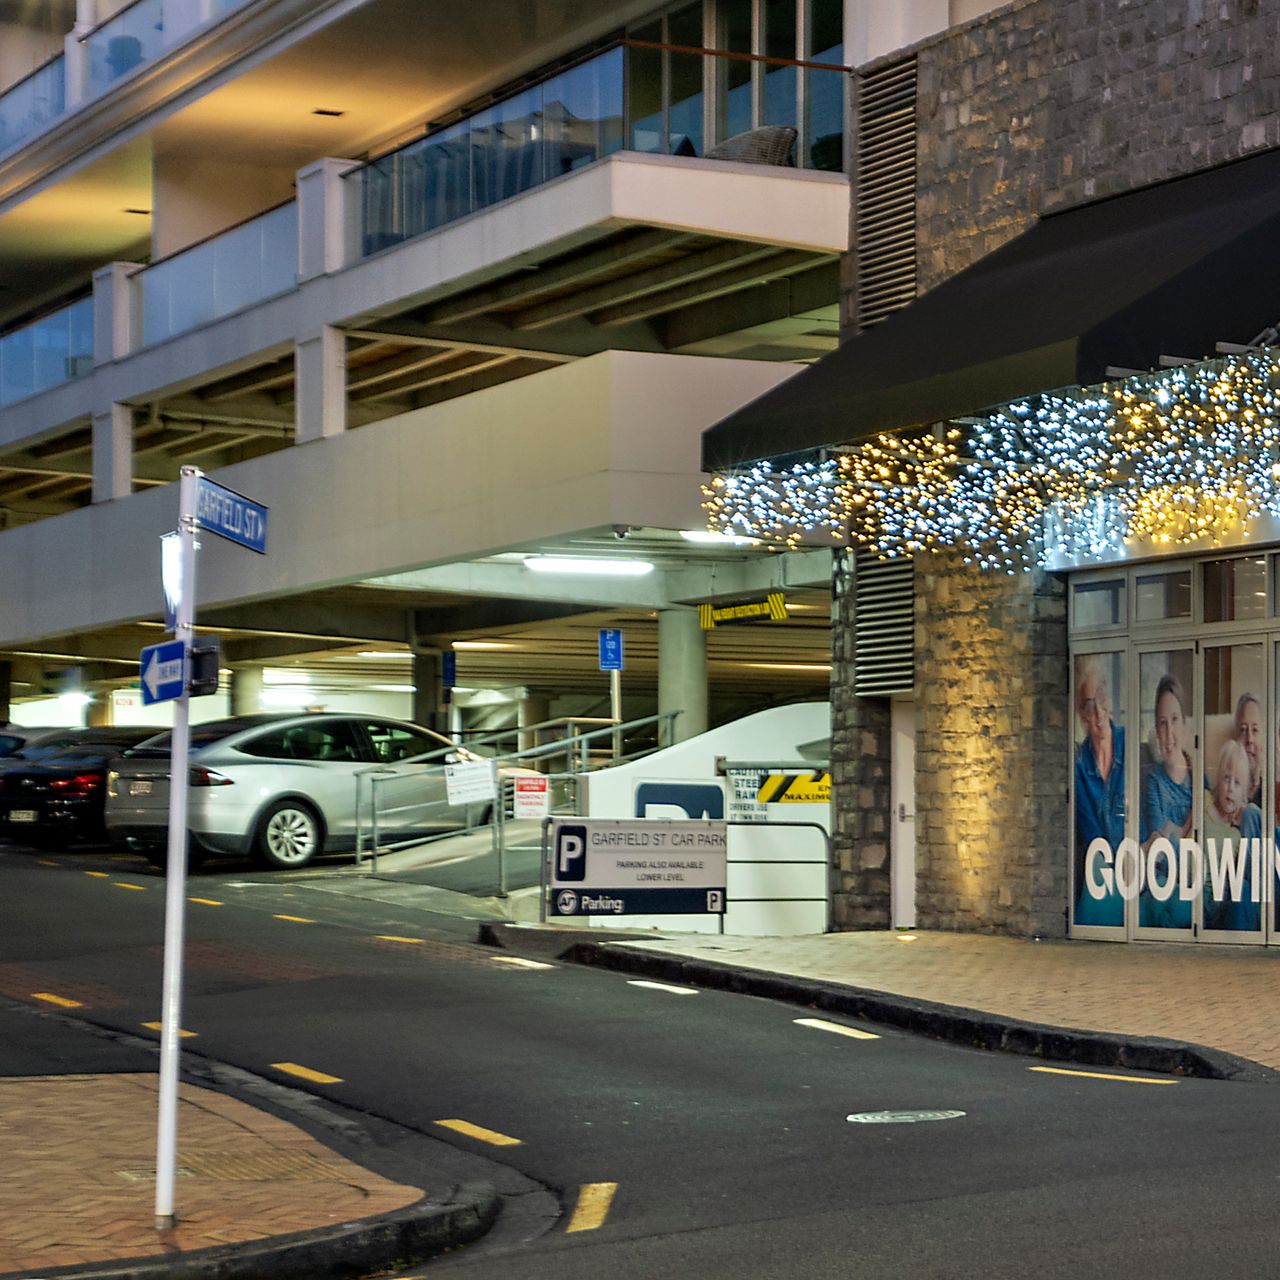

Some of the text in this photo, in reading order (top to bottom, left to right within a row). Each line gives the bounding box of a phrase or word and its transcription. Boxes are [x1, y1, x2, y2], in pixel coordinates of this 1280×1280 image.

[199, 485, 257, 540] GARFIELD ST
[735, 778, 759, 788] STEE
[736, 790, 756, 799] RAM
[592, 832, 726, 847] GARFIELD ST CAR PARK
[559, 835, 583, 872] P
[616, 860, 703, 869] PARKING ALSO AVAILABLE
[636, 873, 684, 882] LOWER LEVEL
[581, 894, 625, 914] Parking
